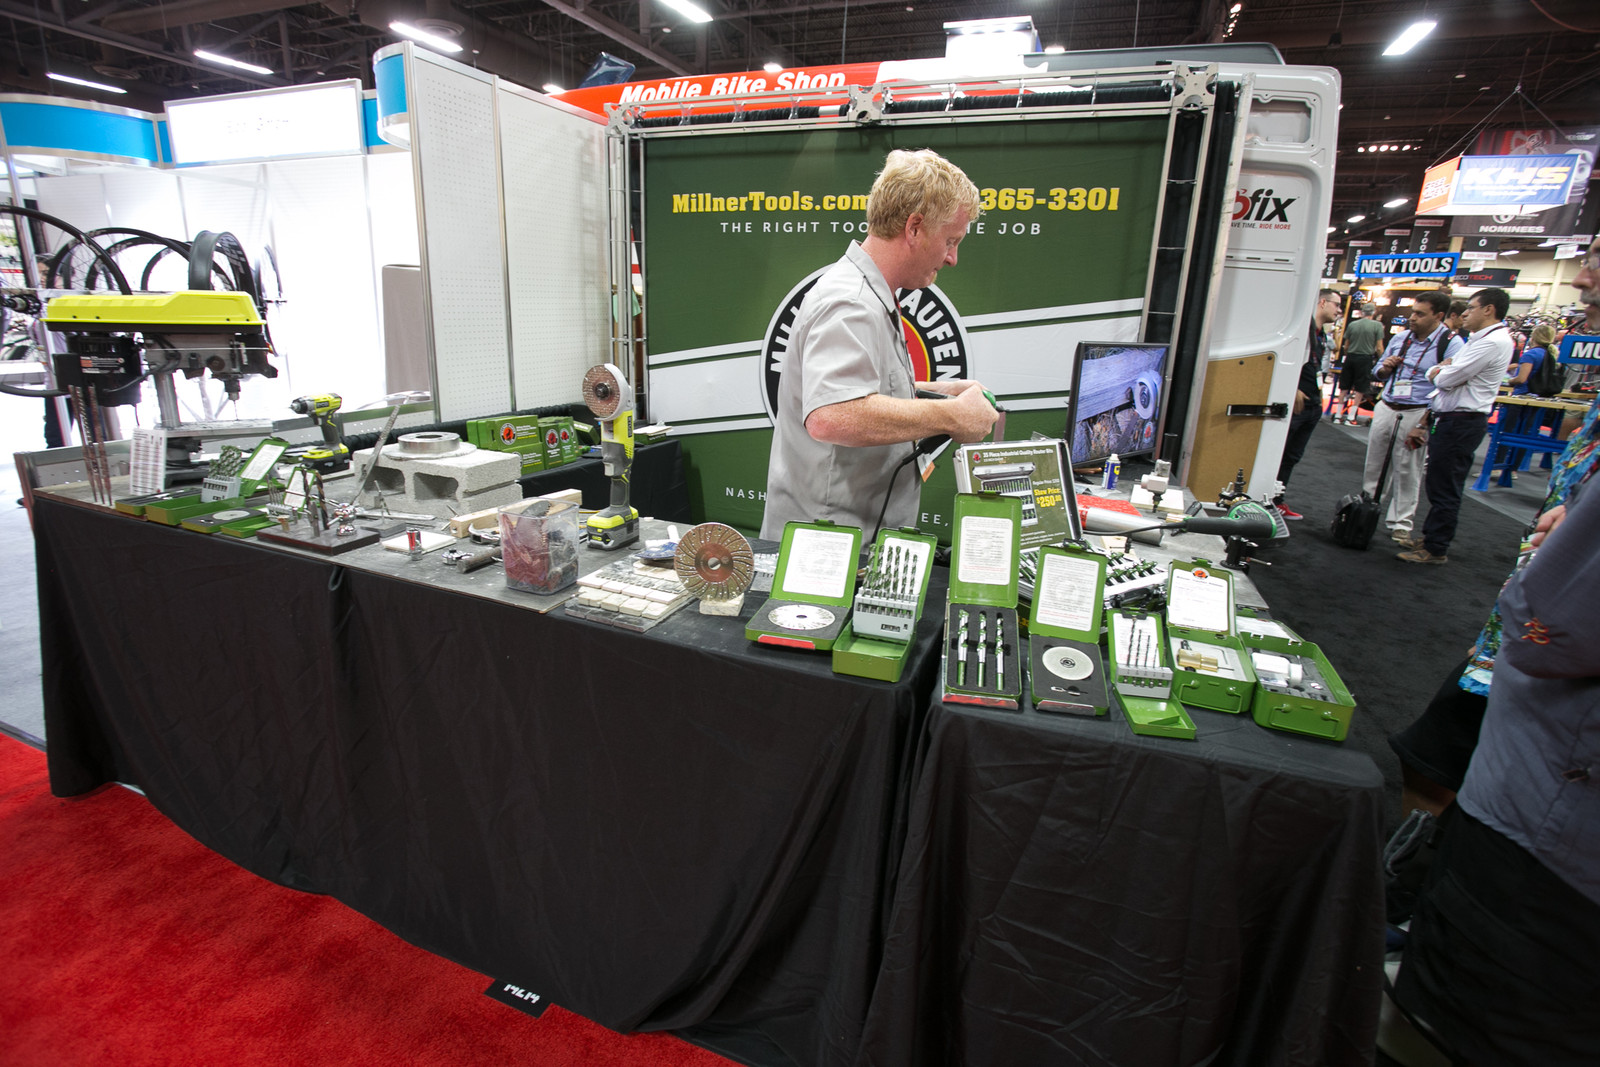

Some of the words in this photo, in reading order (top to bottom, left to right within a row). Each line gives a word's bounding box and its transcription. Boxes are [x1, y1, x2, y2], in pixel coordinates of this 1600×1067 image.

[619, 80, 701, 104] Mobile
[709, 76, 767, 96] Bike
[774, 72, 846, 94] Shop
[1461, 166, 1571, 185] KHS
[672, 191, 871, 214] MillnerTools.com
[979, 187, 1120, 211] 365-3301
[720, 222, 752, 233] THE
[763, 222, 820, 233] RIGHT
[998, 222, 1041, 235] JOB
[1479, 225, 1545, 234] NOMINEES
[1360, 259, 1399, 274] NEW
[1400, 257, 1453, 274] TOOLS
[895, 287, 962, 382] AUFEN
